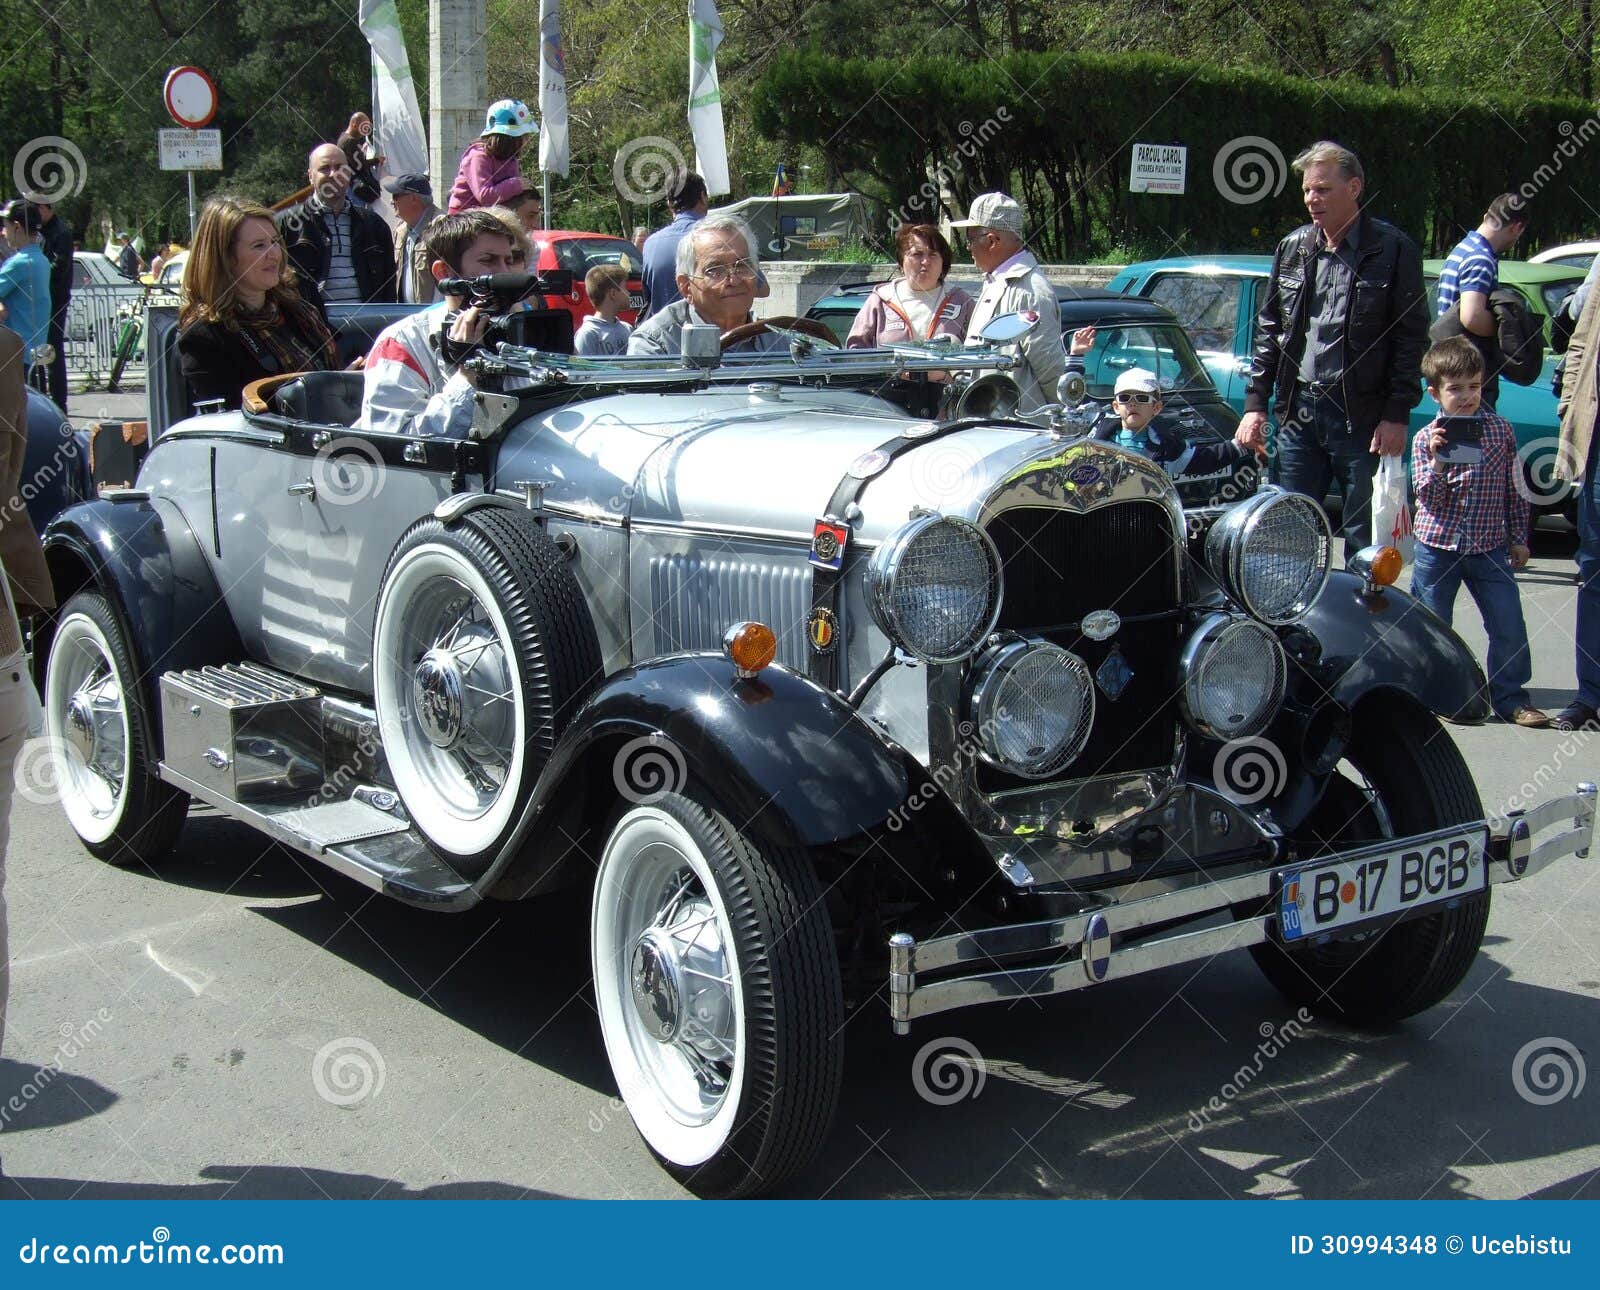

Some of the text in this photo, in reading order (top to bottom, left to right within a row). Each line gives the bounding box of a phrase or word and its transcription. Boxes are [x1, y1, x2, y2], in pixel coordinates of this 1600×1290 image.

[1137, 146, 1182, 164] PARCUL CAROL
[1313, 839, 1470, 924] B 17 BGB
[1282, 910, 1299, 932] RO
